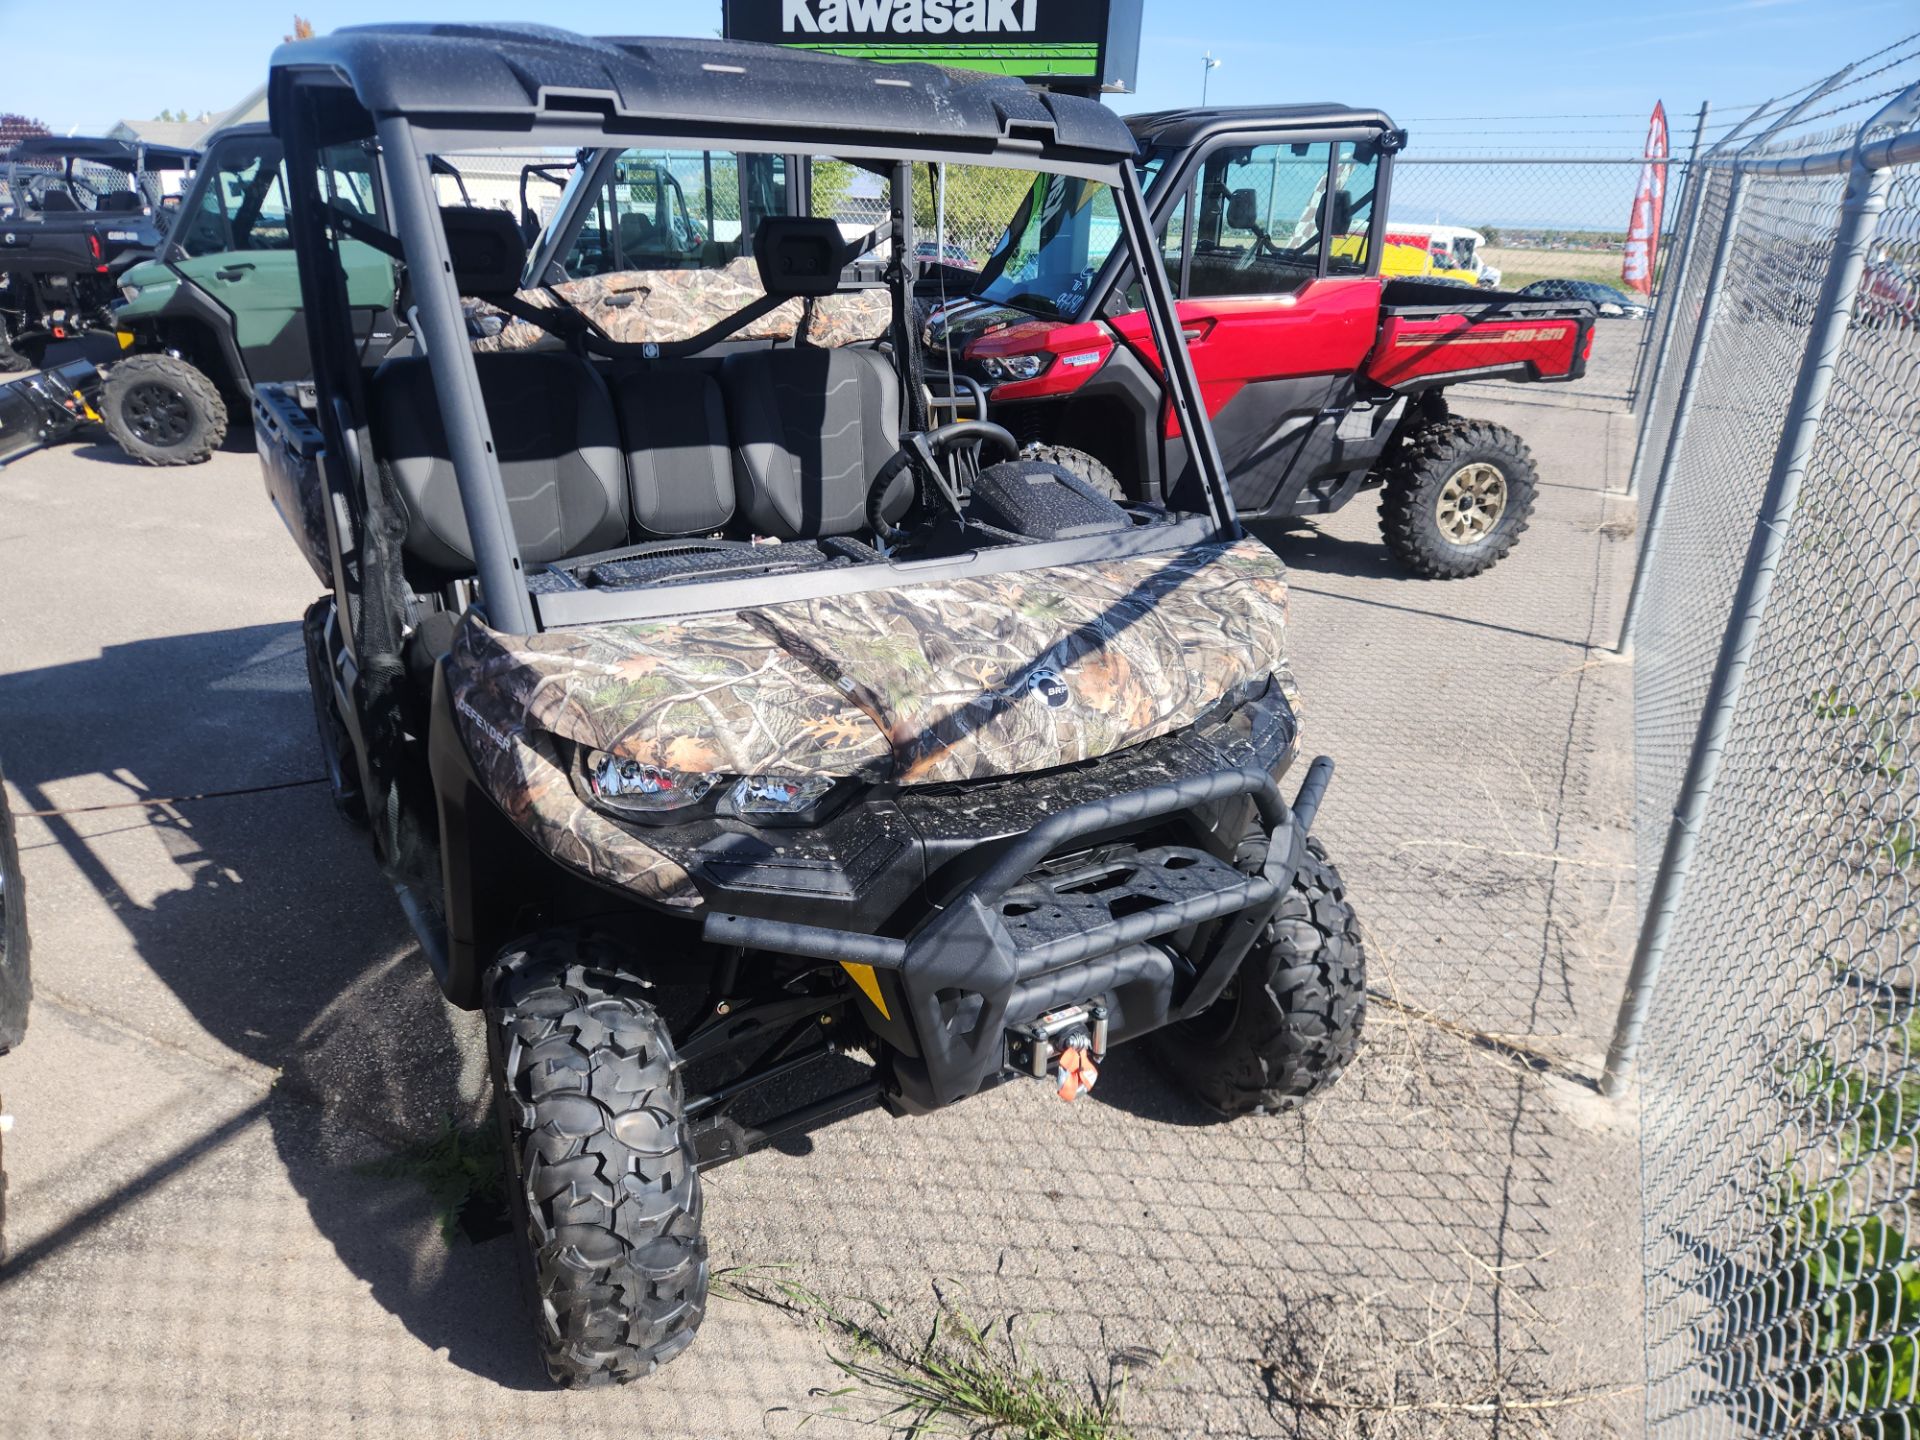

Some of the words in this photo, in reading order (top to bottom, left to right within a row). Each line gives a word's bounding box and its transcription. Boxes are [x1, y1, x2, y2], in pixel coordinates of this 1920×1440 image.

[782, 0, 1038, 34] Kawasaki
[1047, 685, 1068, 696] BRP
[458, 698, 511, 753] DEFENDER
